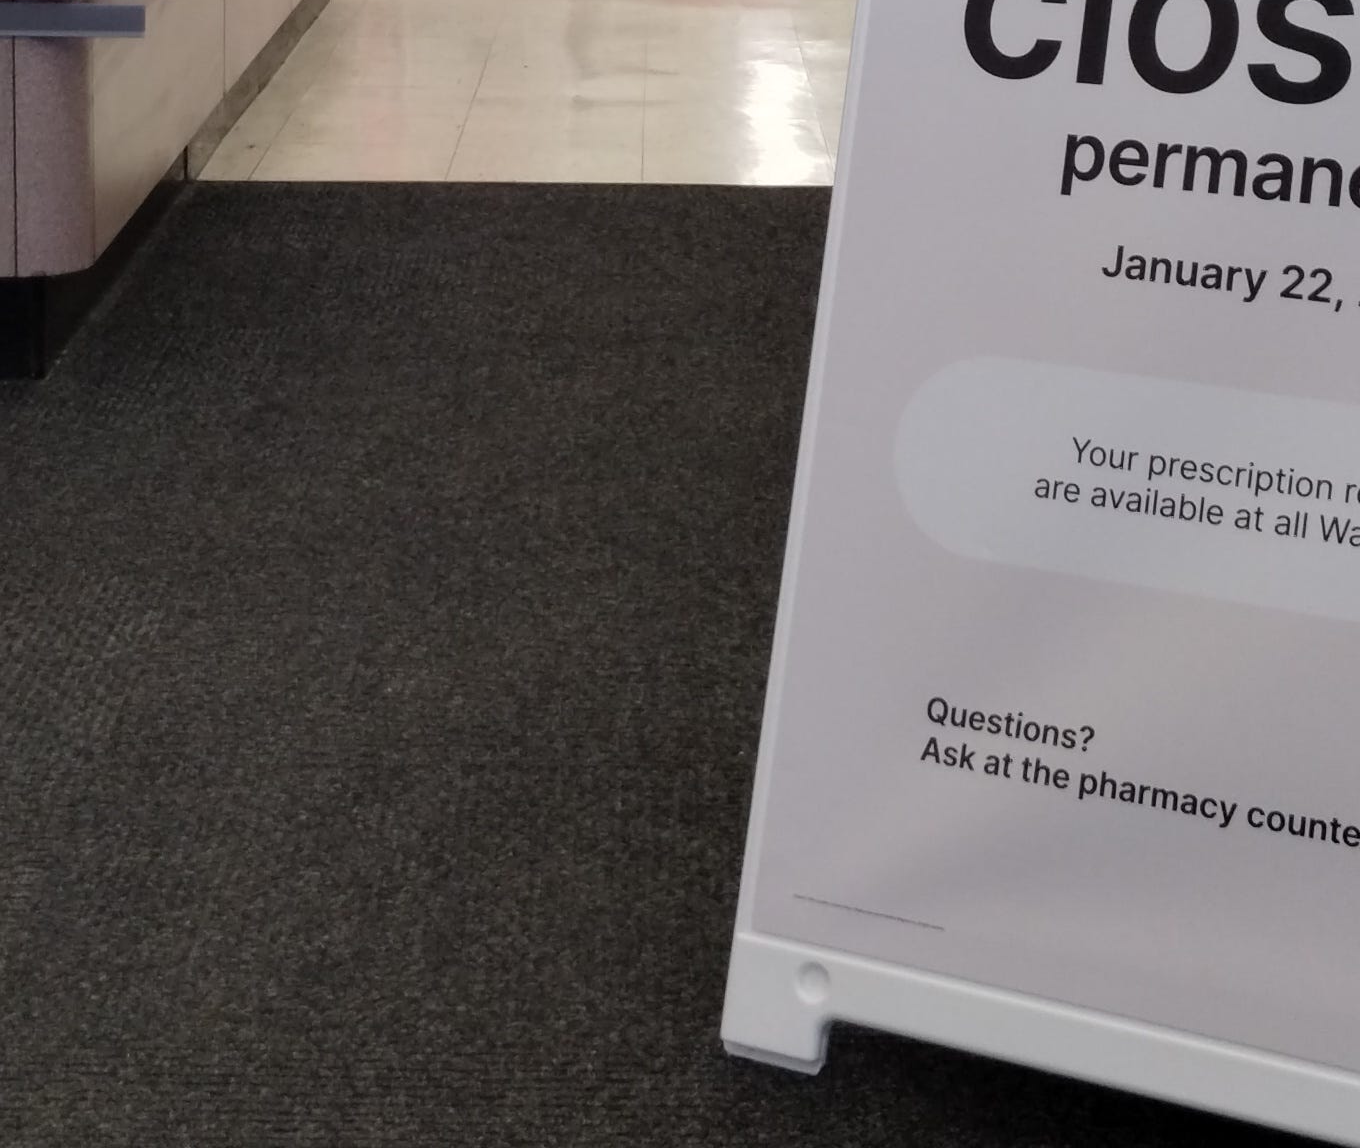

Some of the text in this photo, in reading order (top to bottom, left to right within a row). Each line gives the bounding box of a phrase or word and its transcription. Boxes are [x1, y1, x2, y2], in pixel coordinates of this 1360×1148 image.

[1101, 245, 1269, 303] January
[1280, 265, 1343, 313] 22,
[1072, 436, 1140, 472] Your
[1147, 454, 1333, 501] prescription
[1034, 478, 1081, 504] are
[1090, 486, 1224, 526] available
[1233, 506, 1265, 533] at
[1274, 510, 1309, 539] all
[926, 696, 1096, 753] Questions?
[920, 736, 976, 771] Ask
[983, 753, 1014, 779] at
[1021, 757, 1070, 790] the
[1077, 770, 1239, 829] pharmacy
